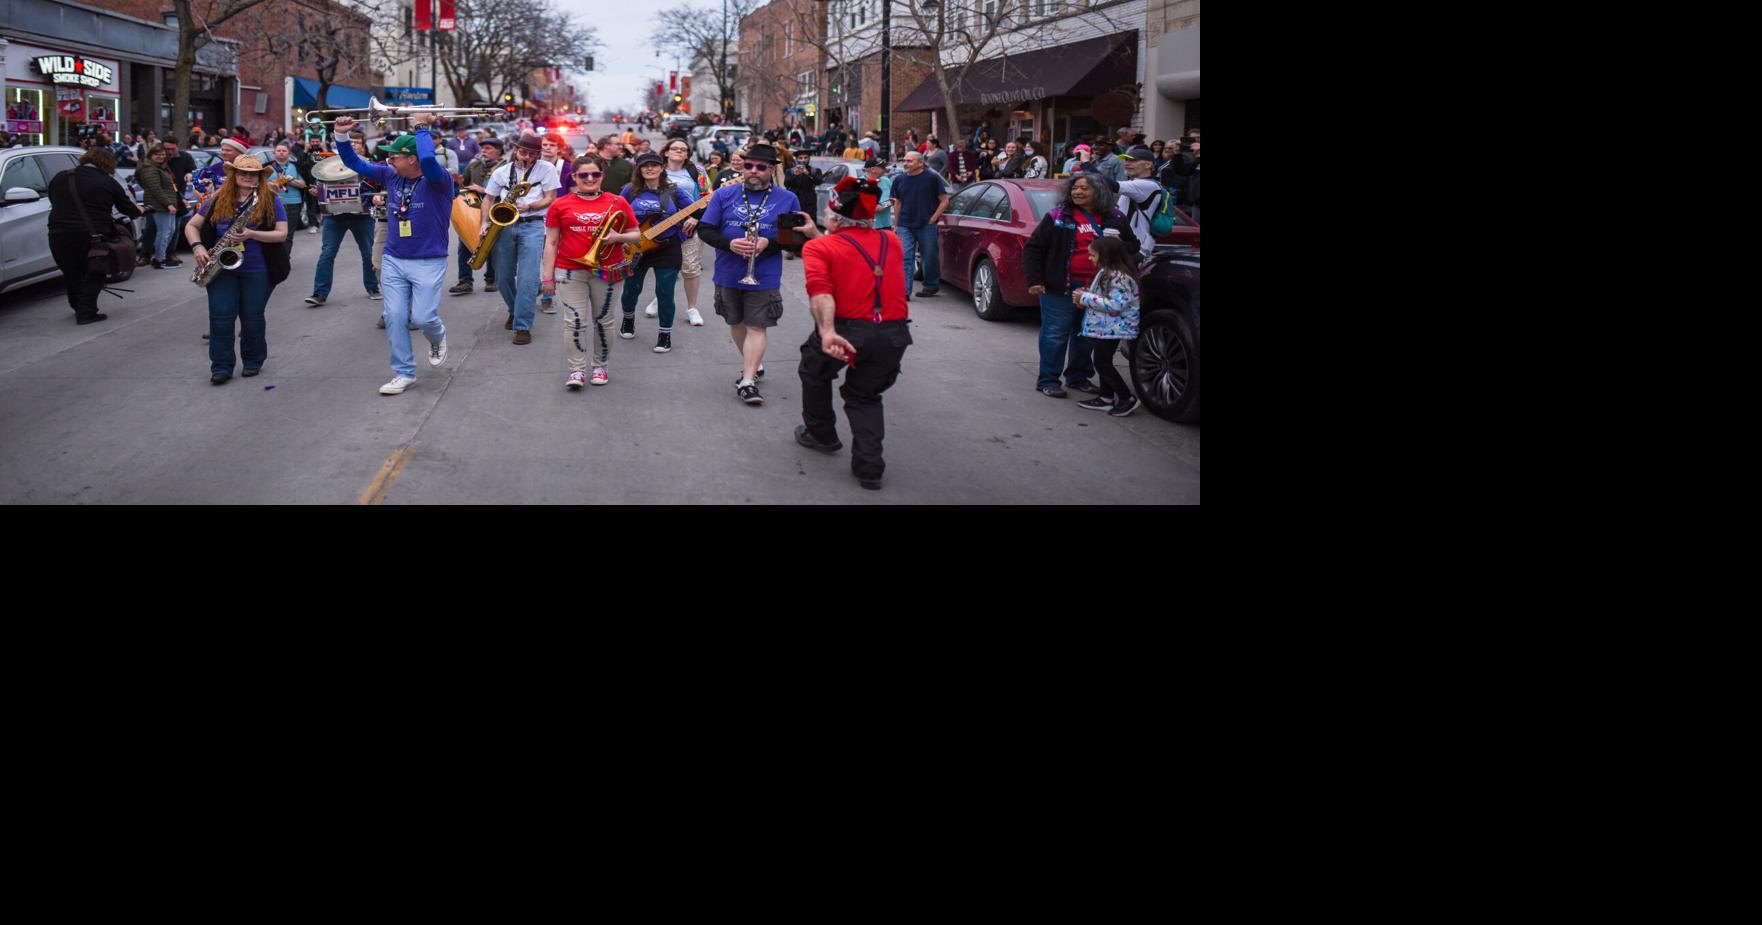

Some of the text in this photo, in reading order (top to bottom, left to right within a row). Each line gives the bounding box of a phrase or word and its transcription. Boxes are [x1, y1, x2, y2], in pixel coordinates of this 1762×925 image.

[38, 56, 112, 84] WILD SIDE
[53, 73, 100, 88] SMOKE SHOP
[326, 188, 359, 199] MFU
